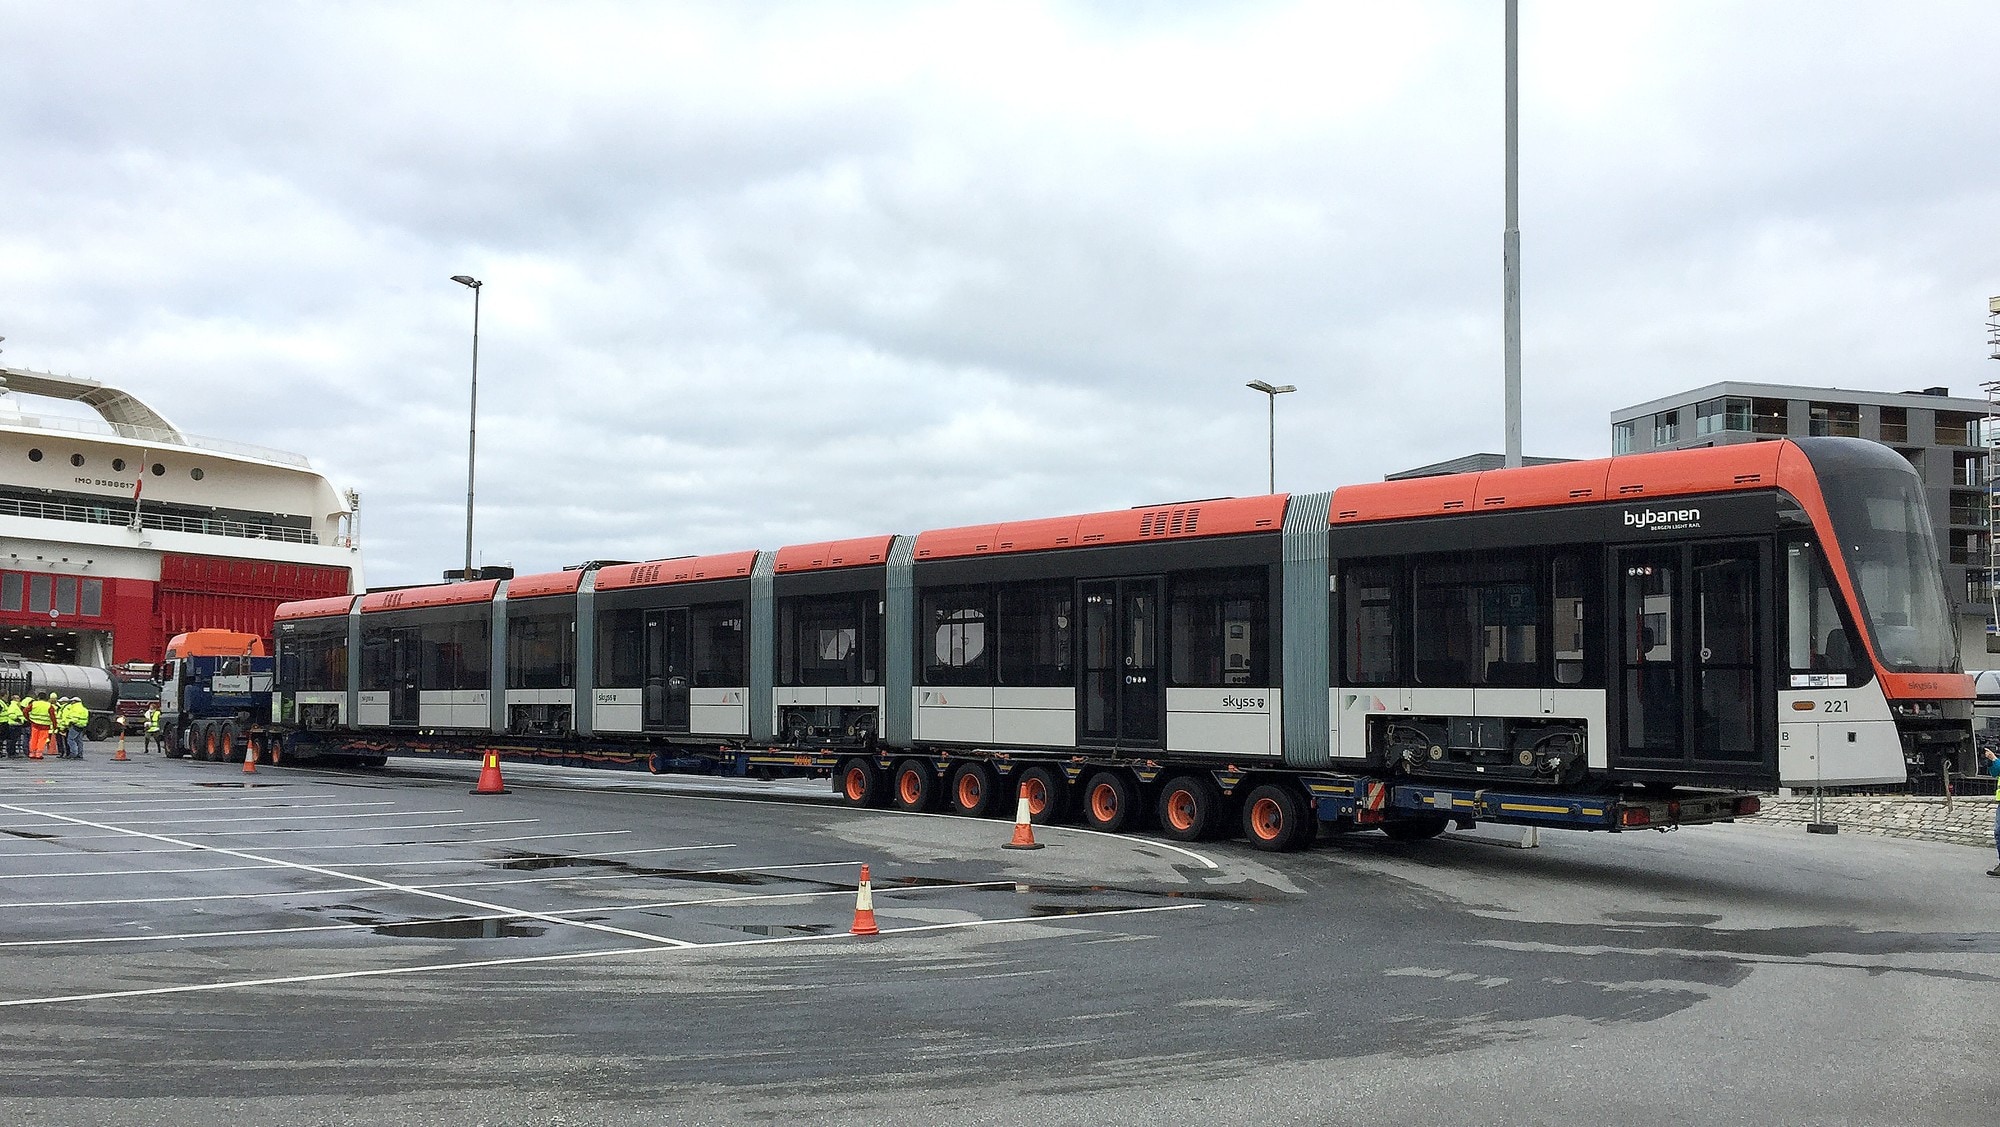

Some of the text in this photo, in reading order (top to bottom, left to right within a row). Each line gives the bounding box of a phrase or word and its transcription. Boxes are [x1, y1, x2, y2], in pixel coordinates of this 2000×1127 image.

[74, 477, 92, 485] IMO
[1624, 508, 1700, 528] bybanen
[1222, 694, 1256, 710] skyss
[1824, 700, 1849, 713] 221
[1781, 732, 1789, 741] B
